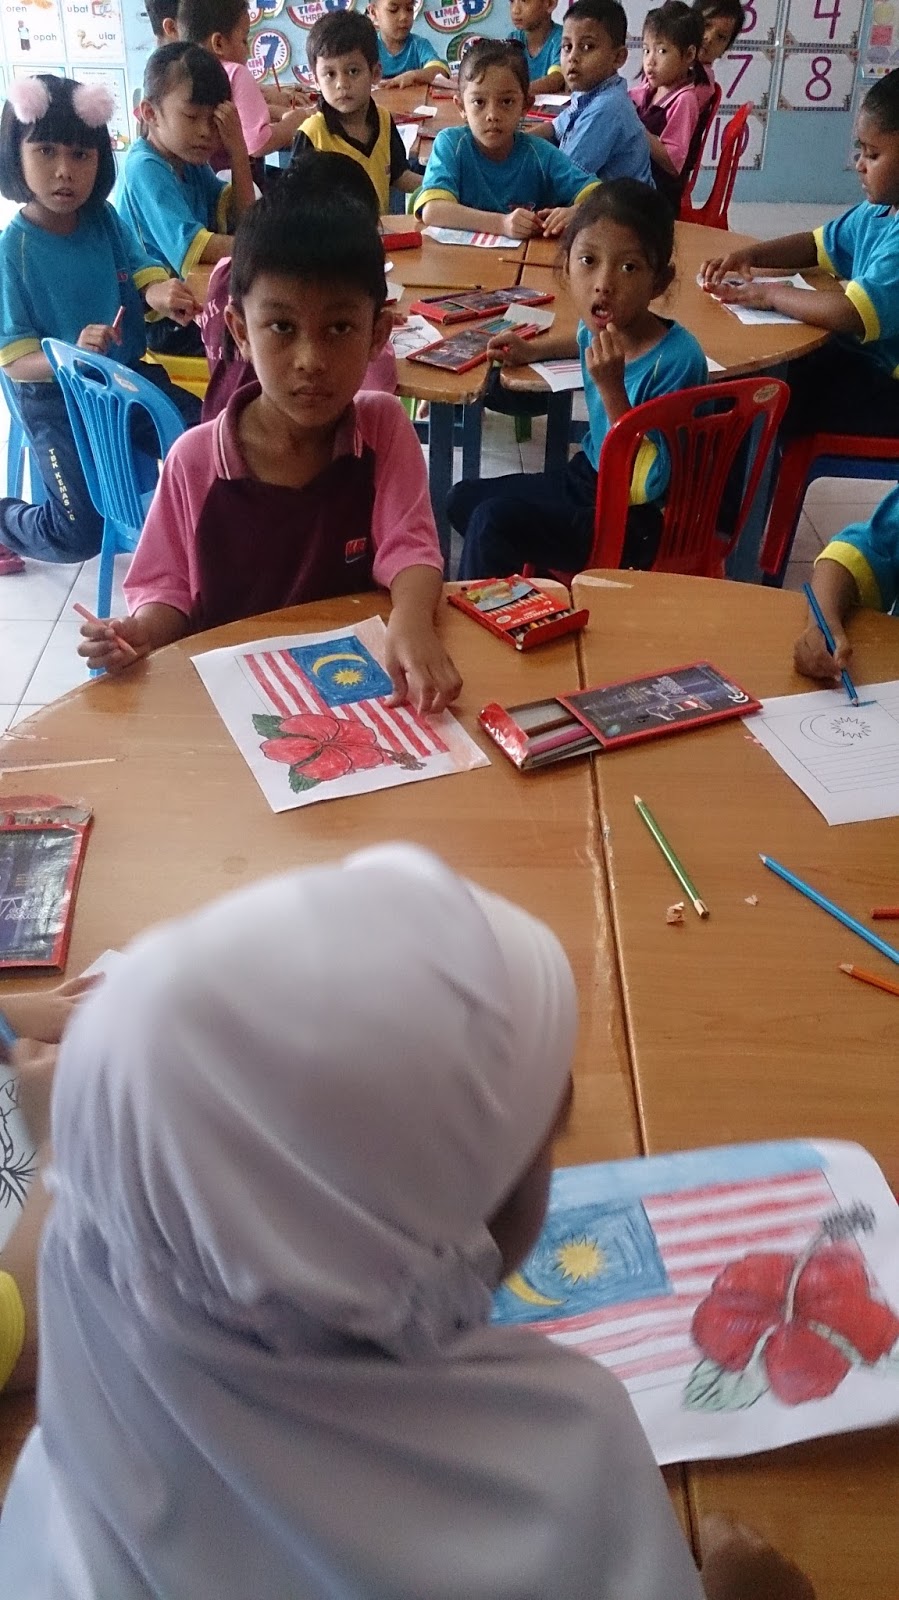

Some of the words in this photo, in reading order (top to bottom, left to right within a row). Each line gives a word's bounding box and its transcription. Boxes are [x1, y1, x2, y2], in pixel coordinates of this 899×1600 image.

[6, 5, 27, 13] oren
[67, 5, 89, 13] ubat
[298, 4, 323, 15] TIGA
[435, 6, 460, 19] LIMA
[443, 16, 460, 26] FIVE
[814, 0, 841, 39] 4
[98, 32, 116, 40] ular
[260, 36, 279, 69] 7
[726, 54, 754, 99] 7
[805, 56, 832, 101] 8
[48, 448, 59, 469] TBK
[54, 471, 70, 506] KEMAS
